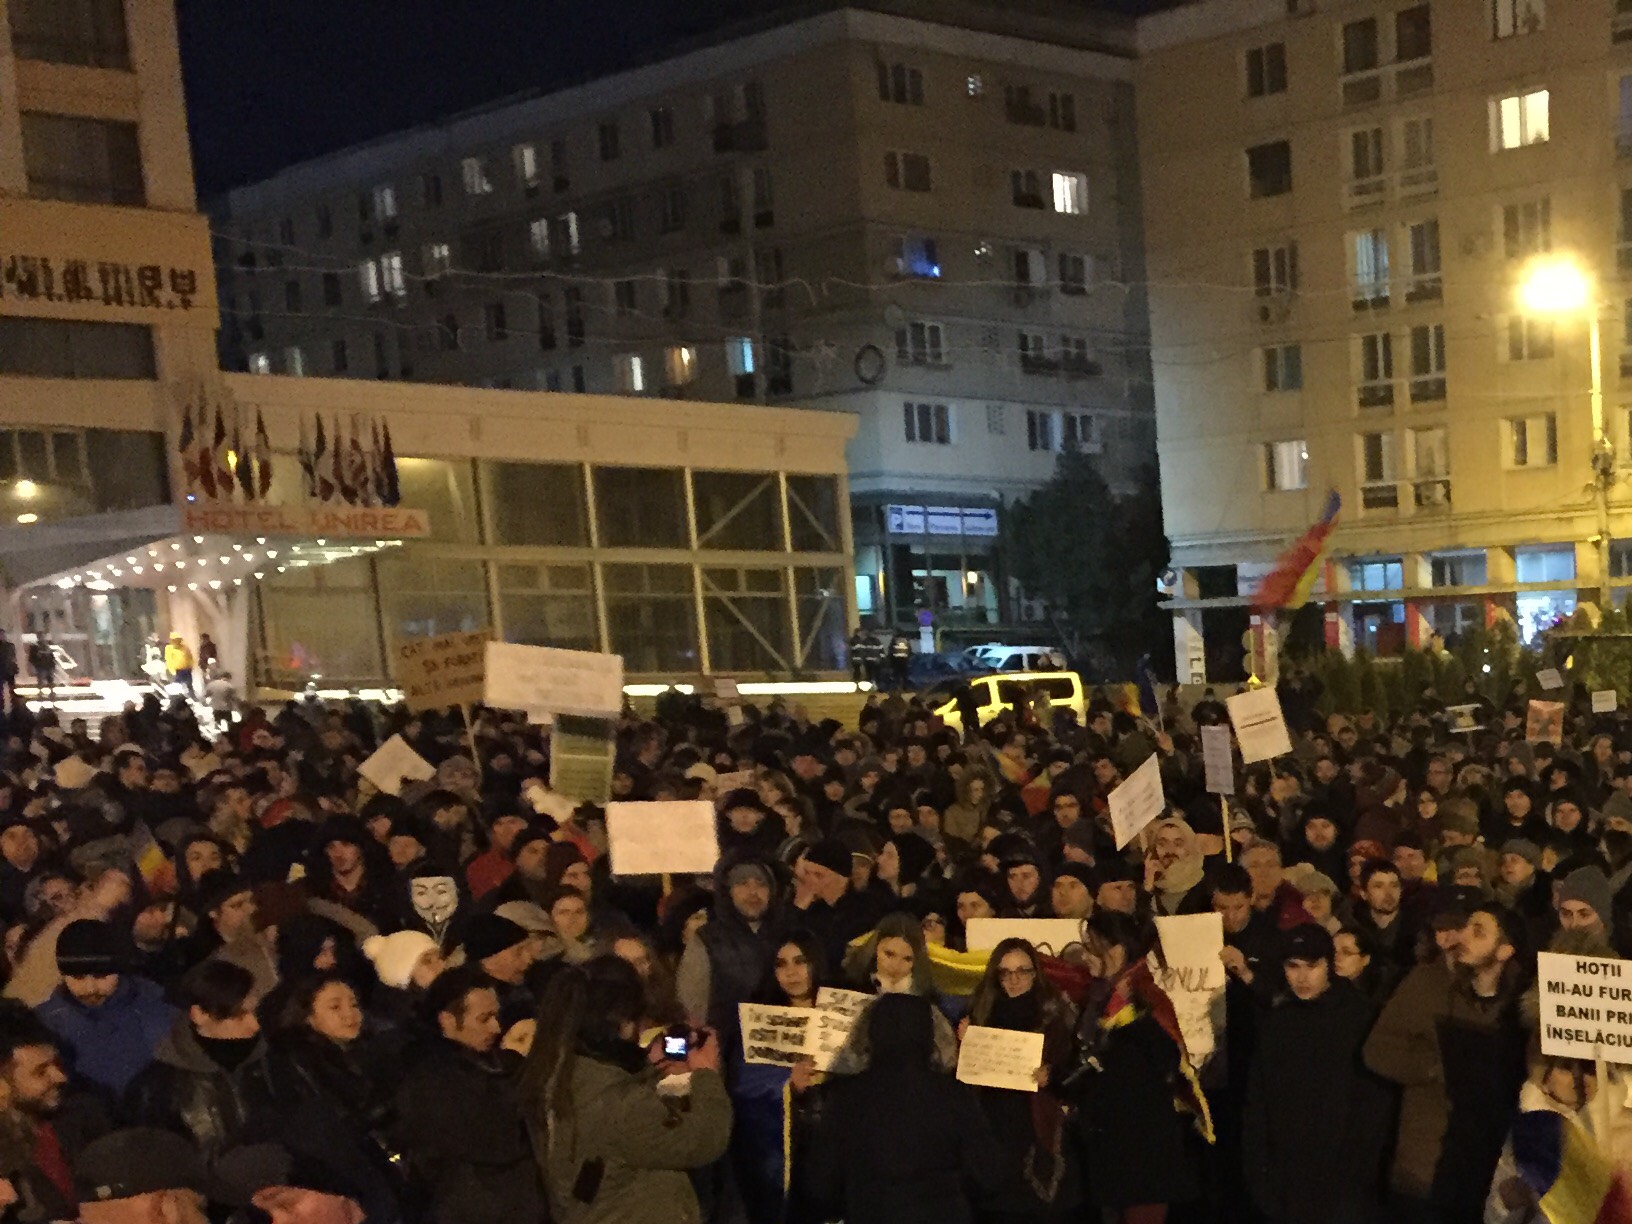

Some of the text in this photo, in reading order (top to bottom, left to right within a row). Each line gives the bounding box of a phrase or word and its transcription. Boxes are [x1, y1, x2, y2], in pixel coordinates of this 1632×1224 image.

[186, 510, 296, 531] HOTEL
[1547, 980, 1593, 998] MI-AU
[1556, 1004, 1600, 1021] BANII
